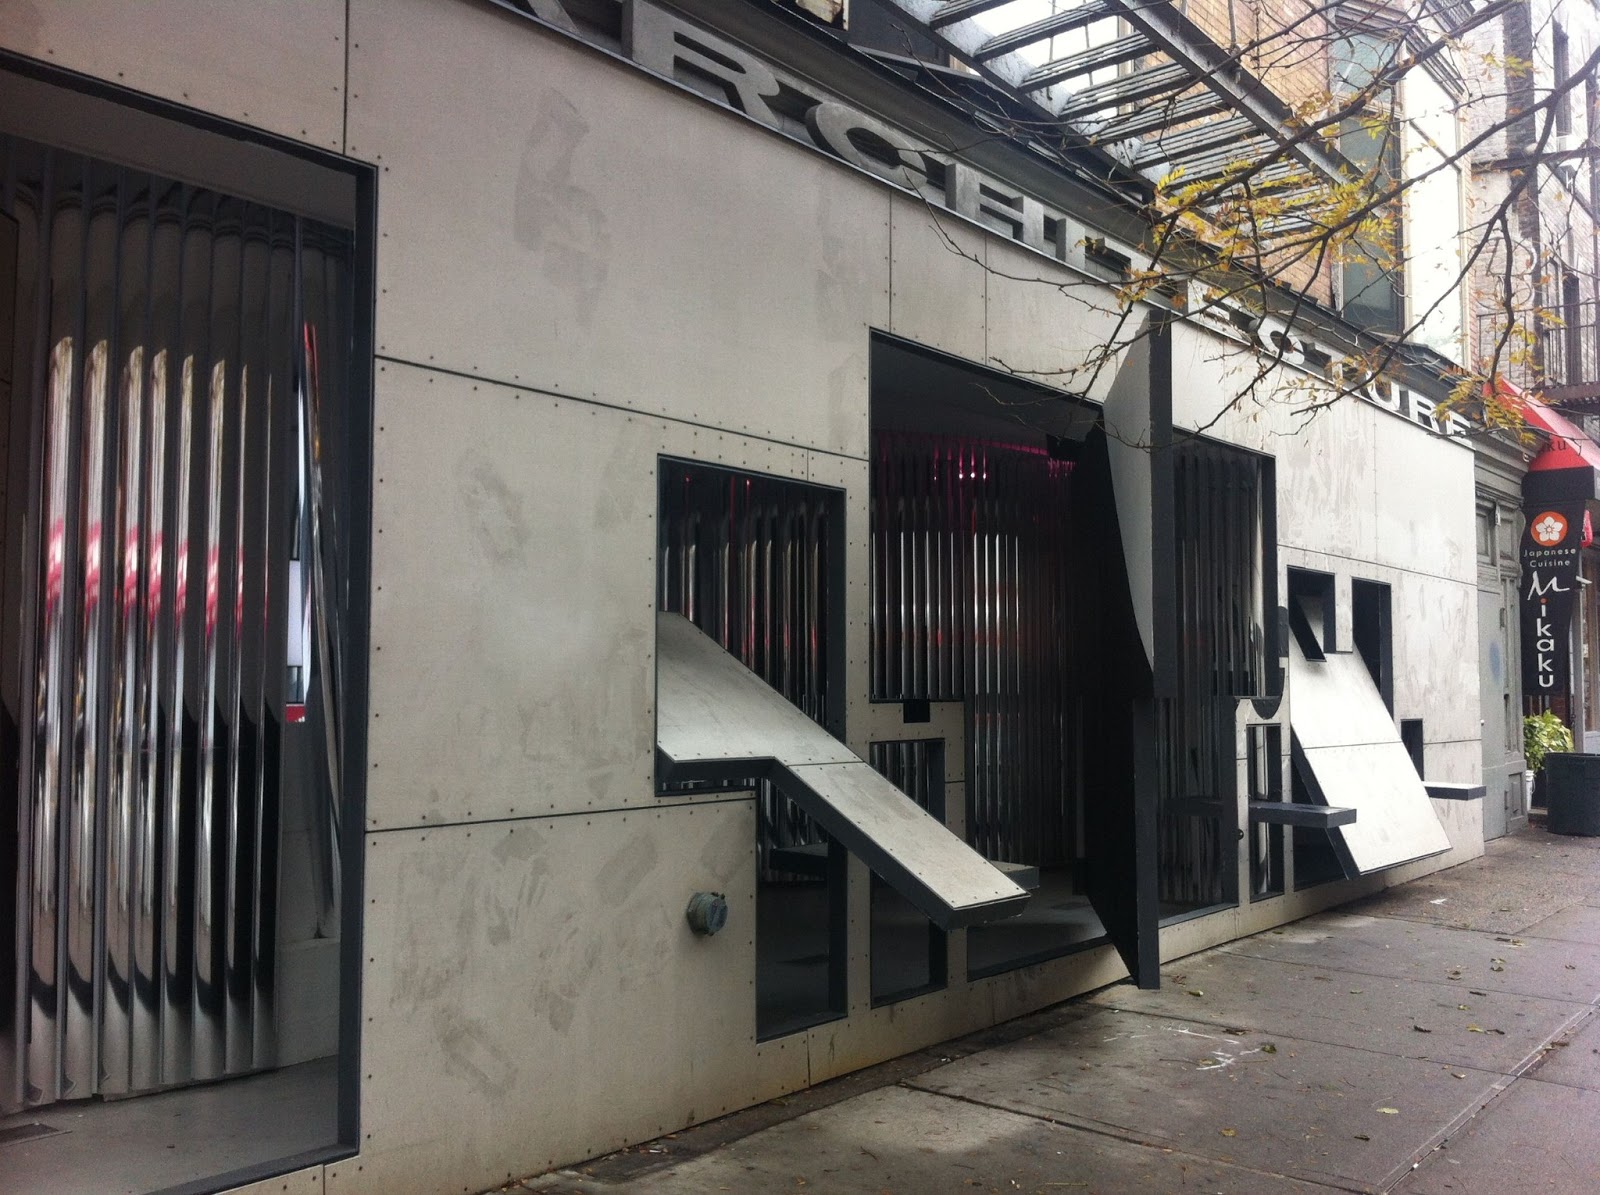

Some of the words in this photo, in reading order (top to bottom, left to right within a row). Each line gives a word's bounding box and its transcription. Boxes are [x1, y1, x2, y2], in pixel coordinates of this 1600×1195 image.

[527, 0, 1472, 446] RCHITECTURE
[1523, 548, 1576, 559] Japanese
[1529, 559, 1571, 568] Cuisine
